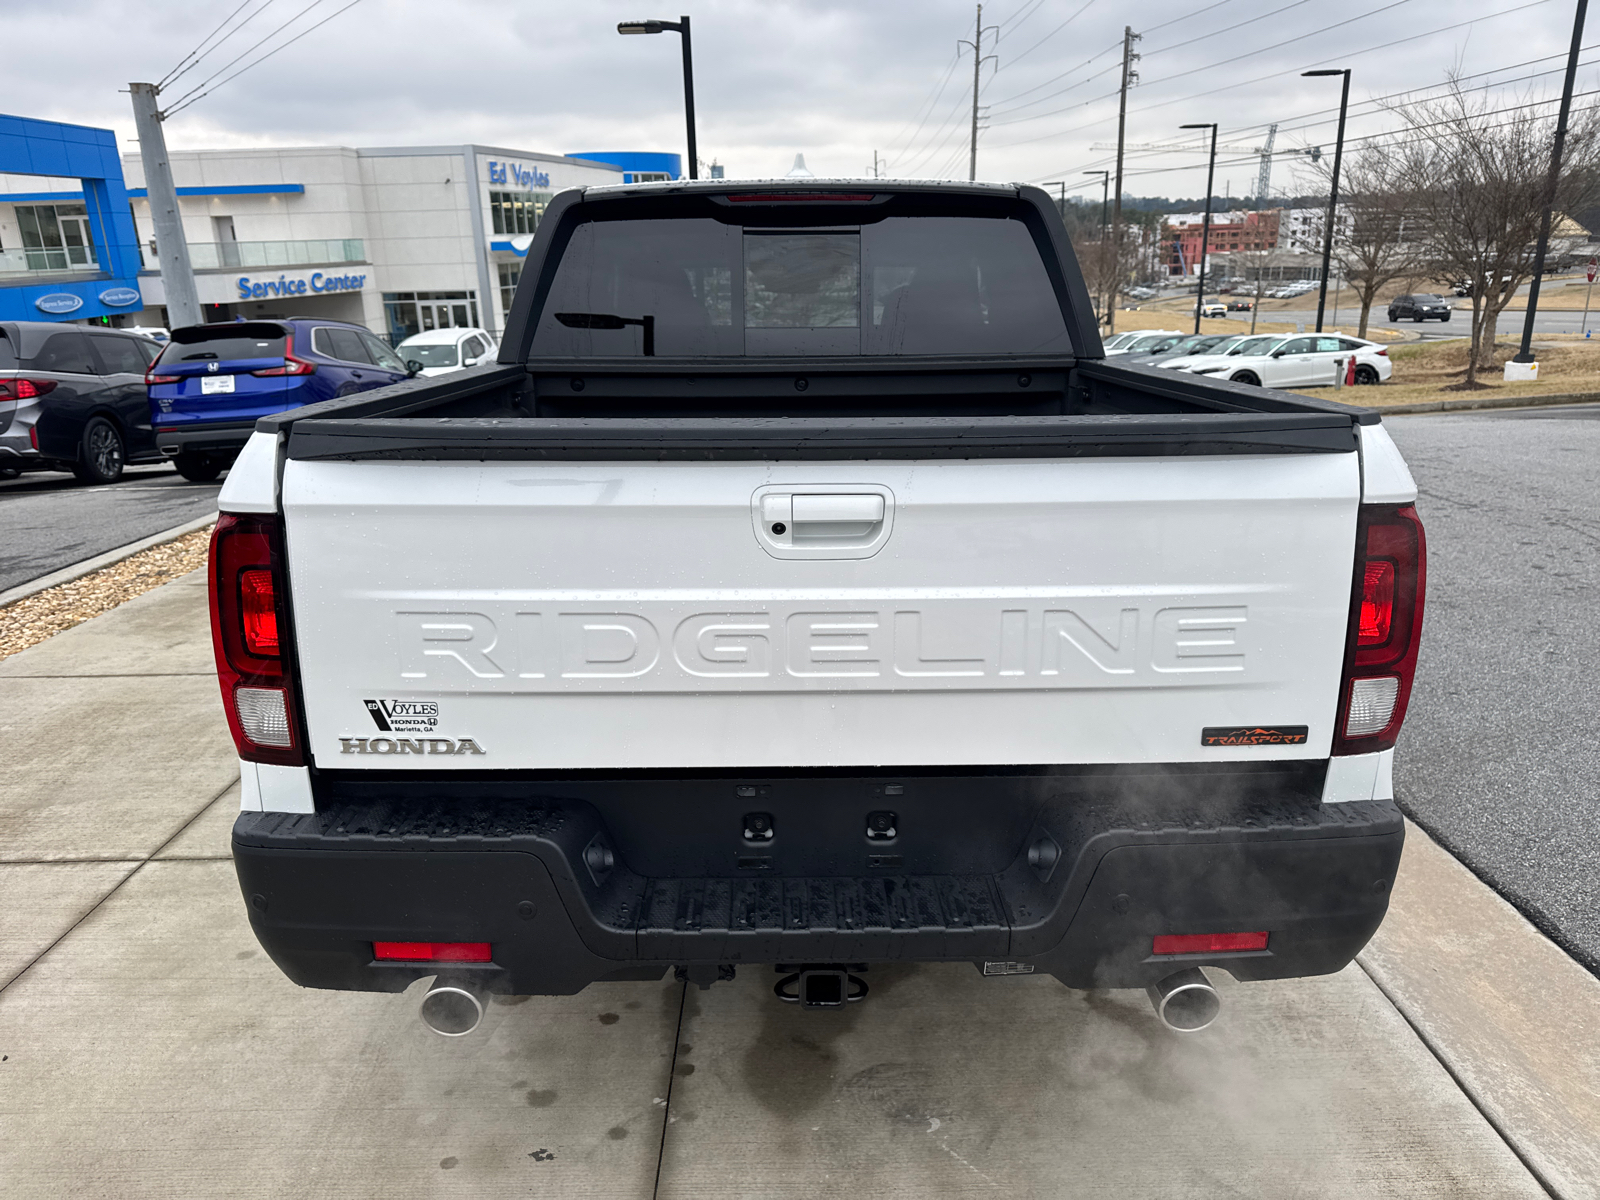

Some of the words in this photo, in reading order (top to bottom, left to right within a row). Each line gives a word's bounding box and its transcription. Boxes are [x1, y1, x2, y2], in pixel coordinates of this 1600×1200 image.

[489, 161, 507, 184] Ed
[511, 163, 550, 191] Voyles
[238, 274, 307, 299] Service
[311, 272, 366, 292] Center
[396, 604, 1249, 680] RIDGELINE
[368, 702, 378, 710] ED
[379, 699, 438, 719] VOYLES
[338, 736, 486, 755] HONDA
[1205, 734, 1306, 746] TRAILSPORT
